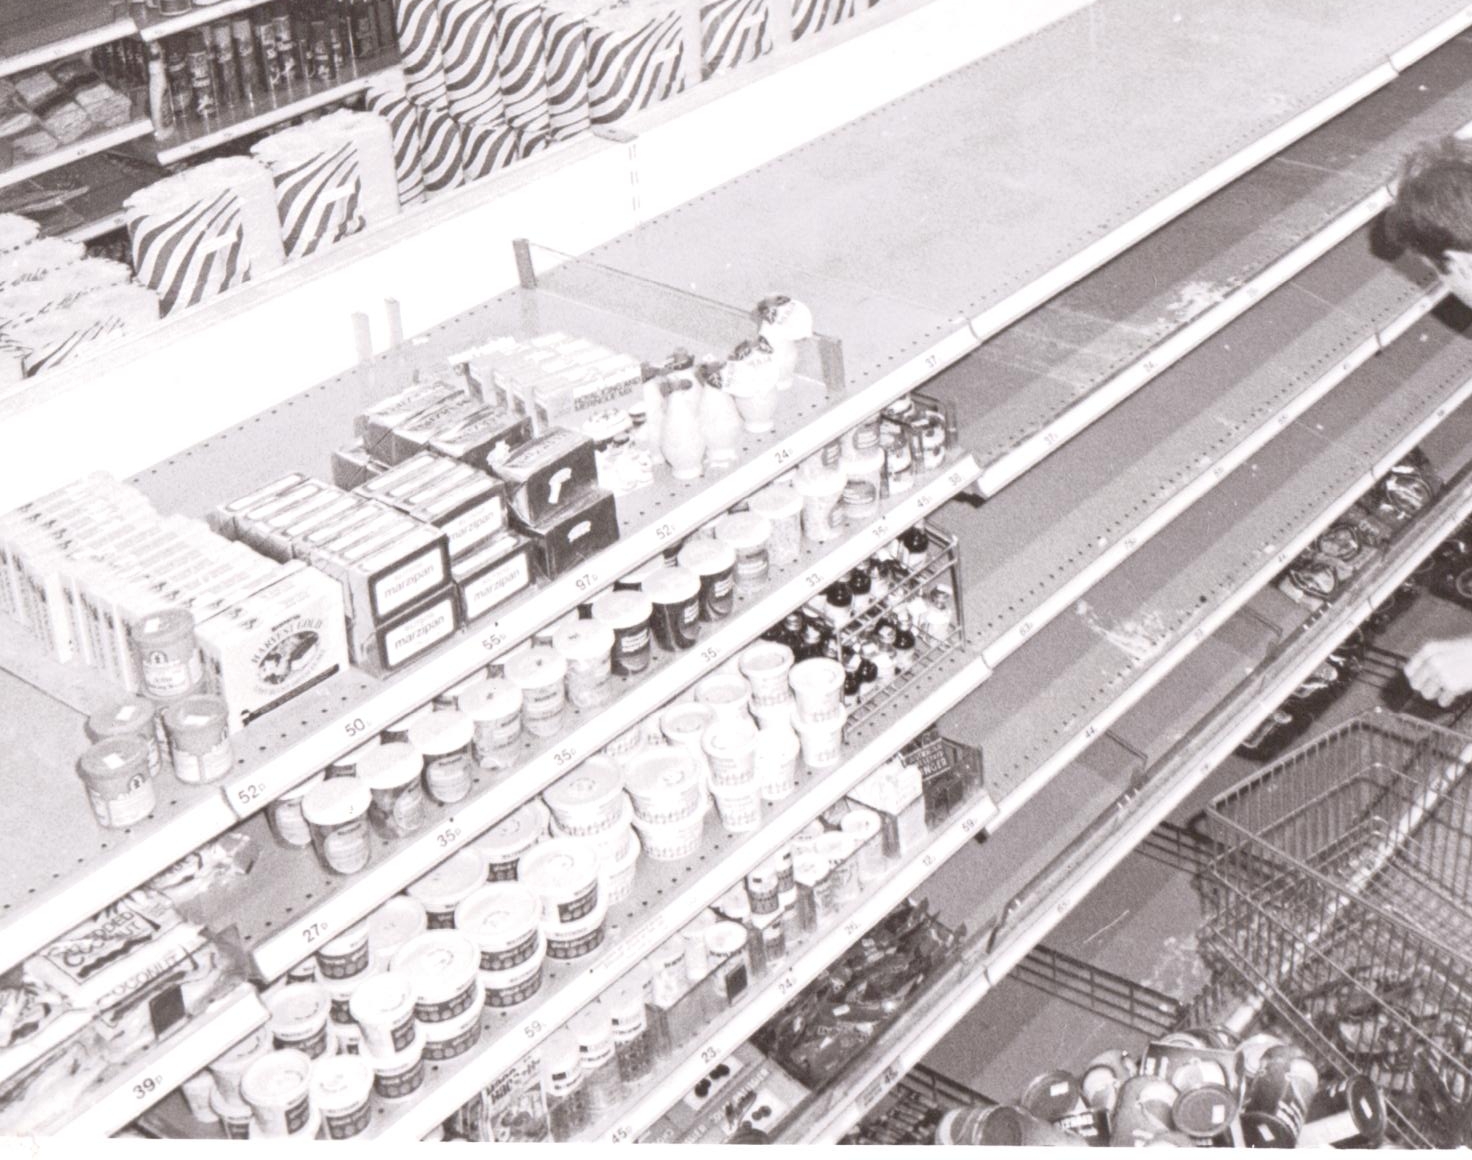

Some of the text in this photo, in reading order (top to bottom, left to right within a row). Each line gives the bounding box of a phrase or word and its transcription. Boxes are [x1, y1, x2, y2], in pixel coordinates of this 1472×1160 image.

[384, 563, 435, 599] marzipan
[473, 567, 520, 601] marzipan
[394, 615, 445, 650] marzipan
[700, 646, 721, 664] 35
[237, 782, 266, 805] 52p
[436, 826, 462, 848] 35p
[302, 922, 329, 943] 27p
[132, 1074, 163, 1100] 39p
